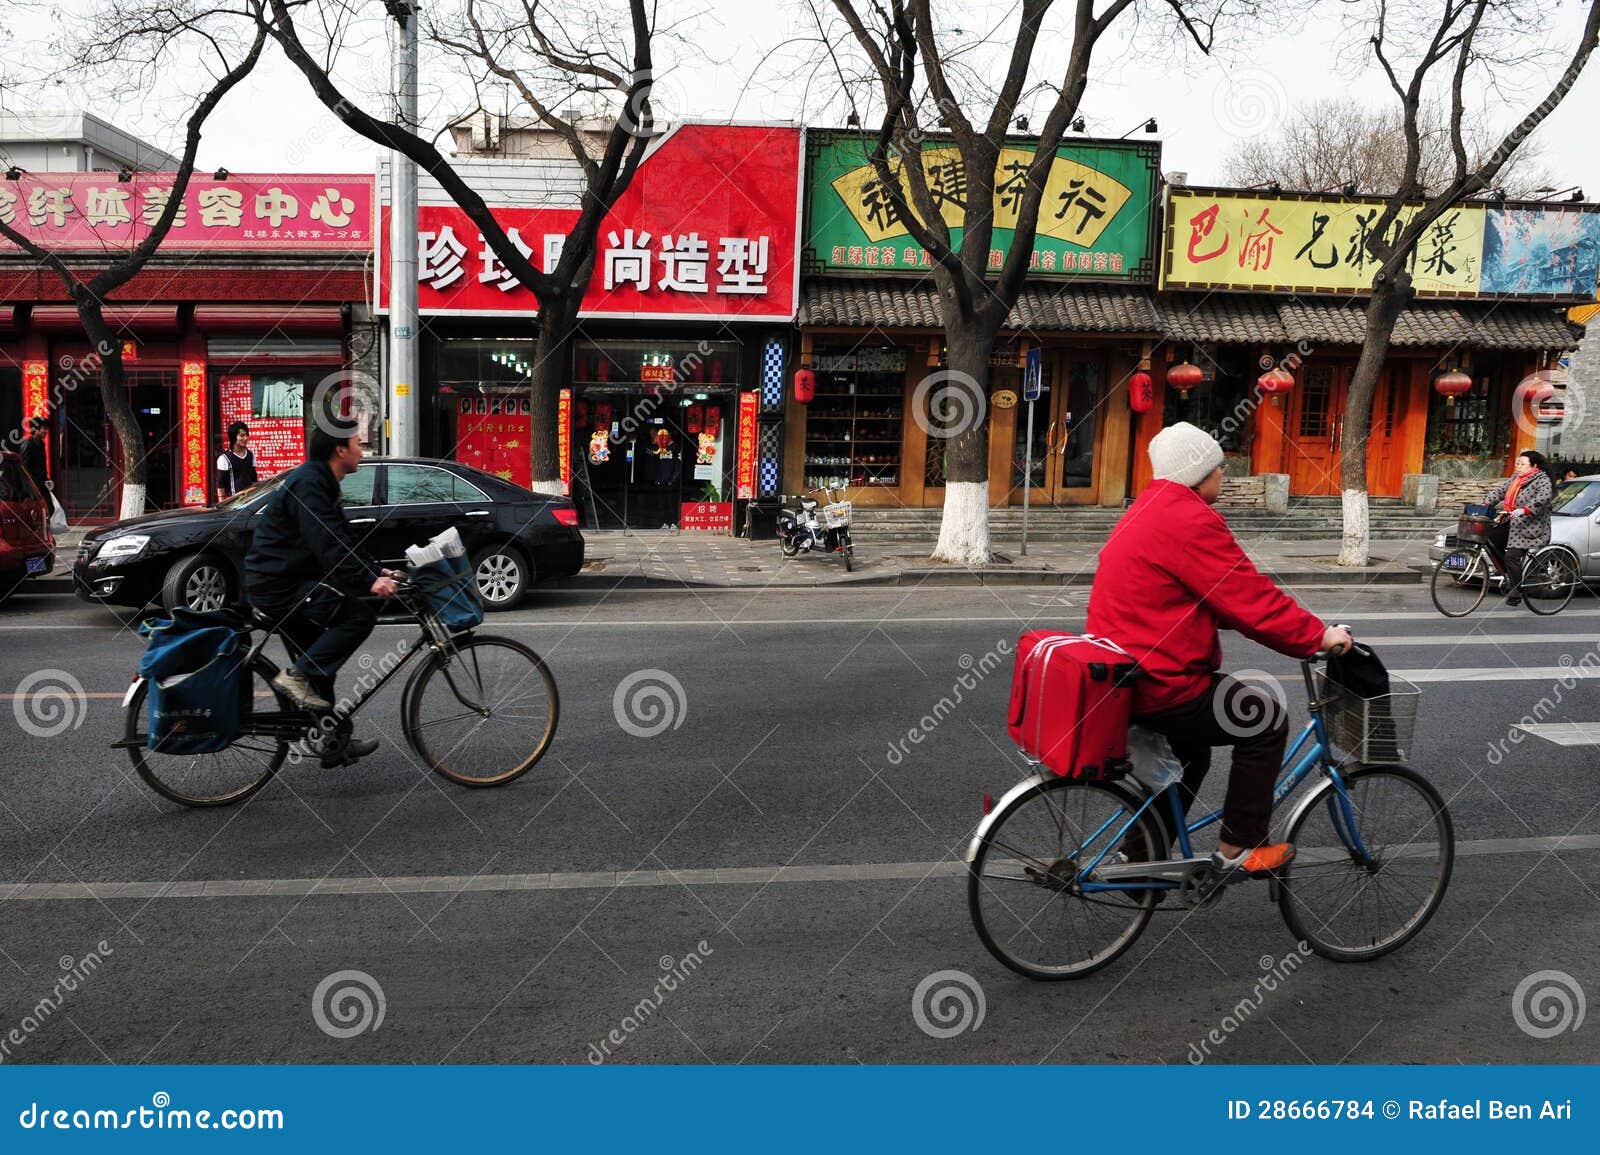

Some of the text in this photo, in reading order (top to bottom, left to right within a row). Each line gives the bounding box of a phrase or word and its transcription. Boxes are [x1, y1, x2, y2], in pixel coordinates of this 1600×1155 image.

[832, 246, 896, 266] 红绿花茶
[1063, 251, 1123, 271] 休闲茶馆
